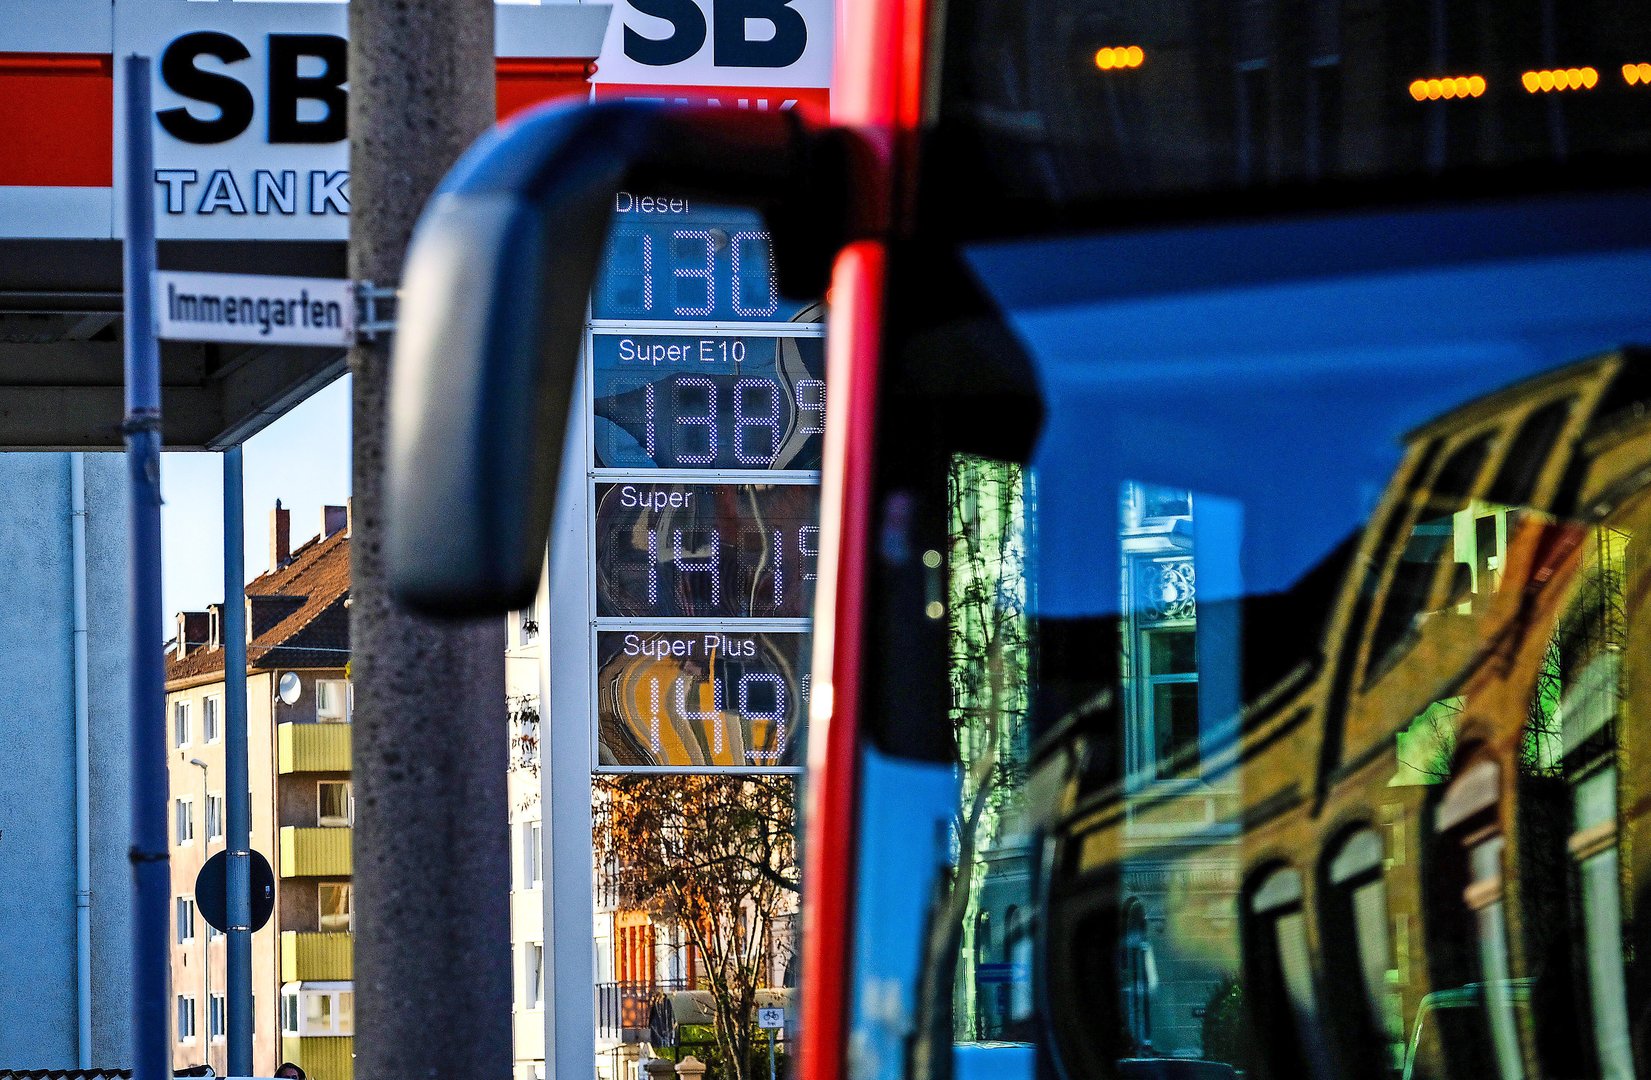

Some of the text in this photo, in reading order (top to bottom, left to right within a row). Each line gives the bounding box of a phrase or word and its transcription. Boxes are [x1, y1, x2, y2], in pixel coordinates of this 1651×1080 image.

[623, 0, 807, 67] SB
[156, 31, 348, 145] SB
[155, 169, 349, 215] TANK
[616, 191, 689, 213] Diesel
[168, 282, 342, 335] Immengarten
[619, 339, 746, 365] Super E10
[620, 486, 693, 512] Super
[623, 634, 756, 660] Super Plus
